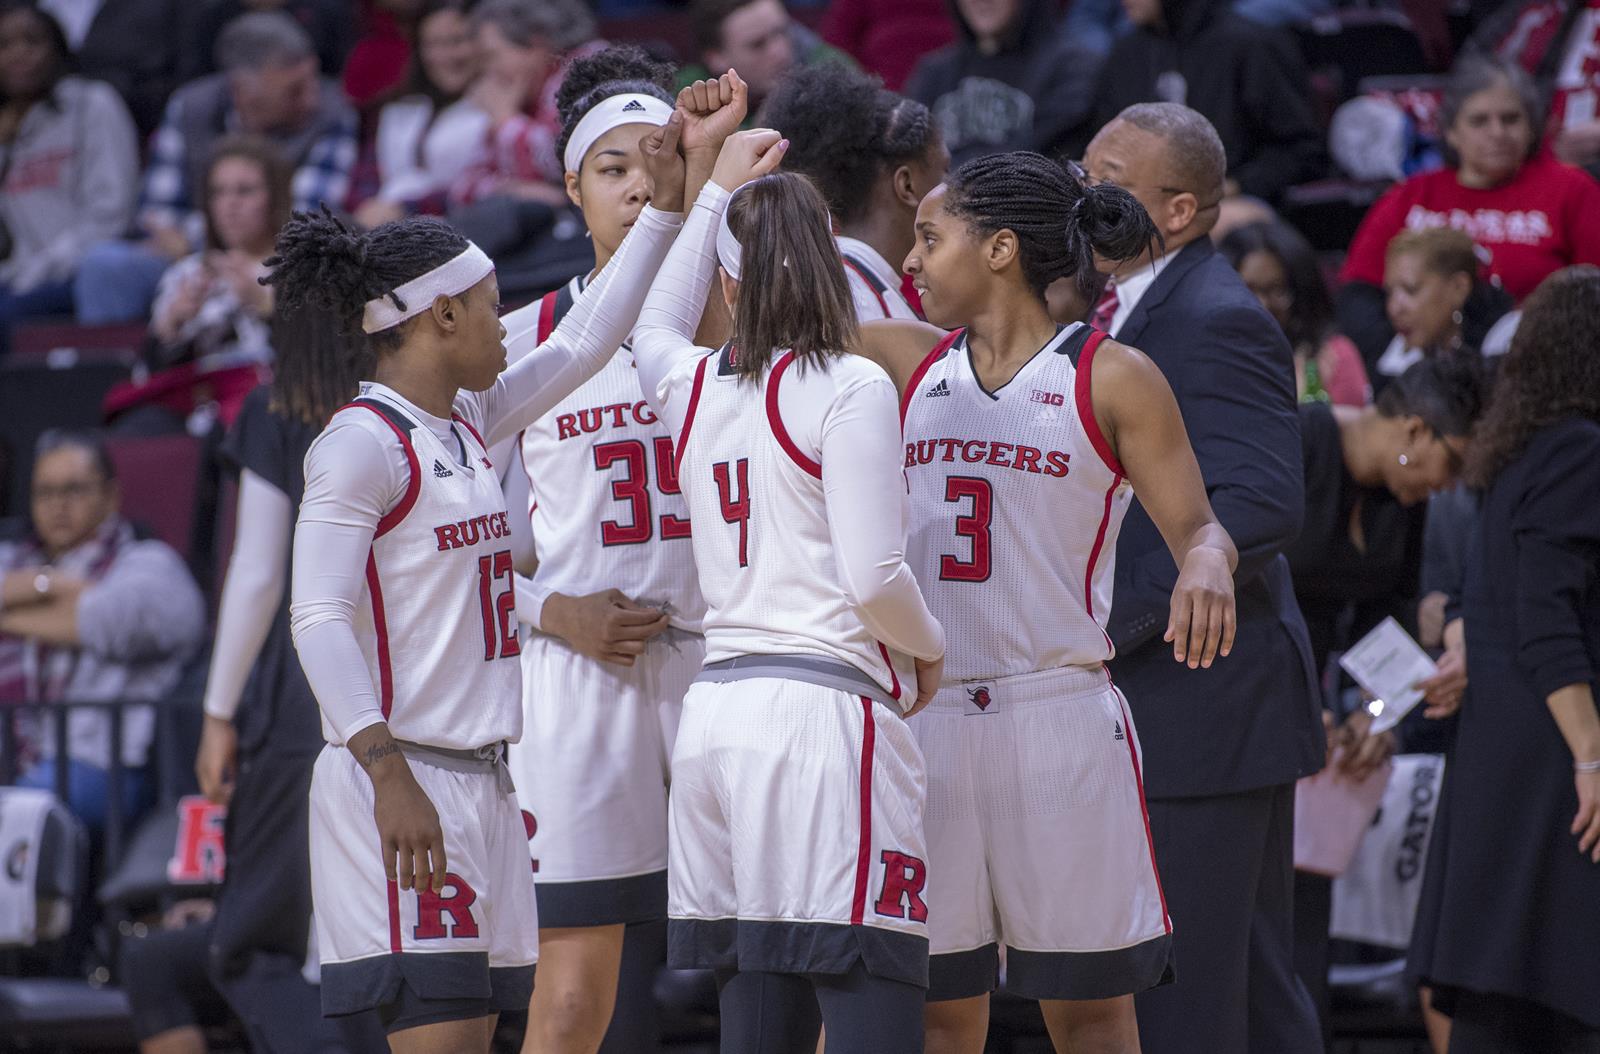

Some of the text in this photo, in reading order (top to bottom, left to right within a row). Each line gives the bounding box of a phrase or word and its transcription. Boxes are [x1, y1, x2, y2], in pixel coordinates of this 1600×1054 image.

[556, 400, 658, 441] RUTG
[926, 390, 951, 398] adidas
[593, 436, 691, 547] 35
[905, 438, 1071, 478] RUTGERS
[434, 511, 511, 551] RUTGE
[712, 457, 751, 568] 4
[939, 475, 993, 583] 3
[479, 549, 520, 661] 12
[412, 872, 479, 940] R
[875, 849, 929, 924] R
